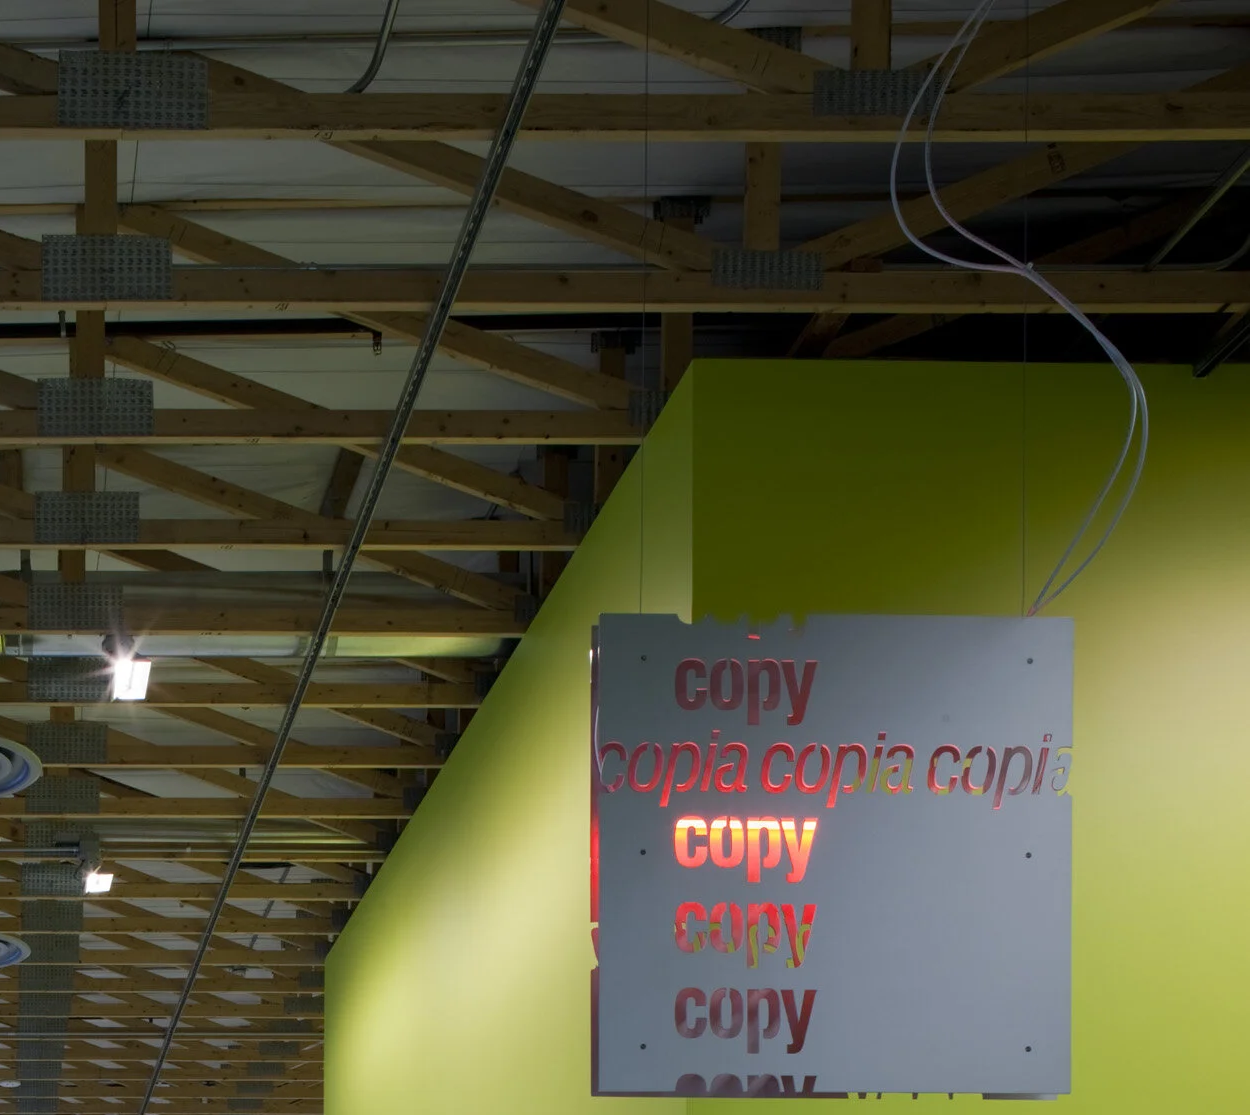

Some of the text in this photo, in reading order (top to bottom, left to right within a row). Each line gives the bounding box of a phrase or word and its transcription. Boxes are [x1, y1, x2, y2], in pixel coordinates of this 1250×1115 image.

[674, 657, 818, 726] copy
[599, 729, 749, 808] copia
[760, 731, 916, 809] copia
[674, 815, 818, 883] copy
[674, 901, 818, 969] copy
[674, 987, 818, 1054] copy
